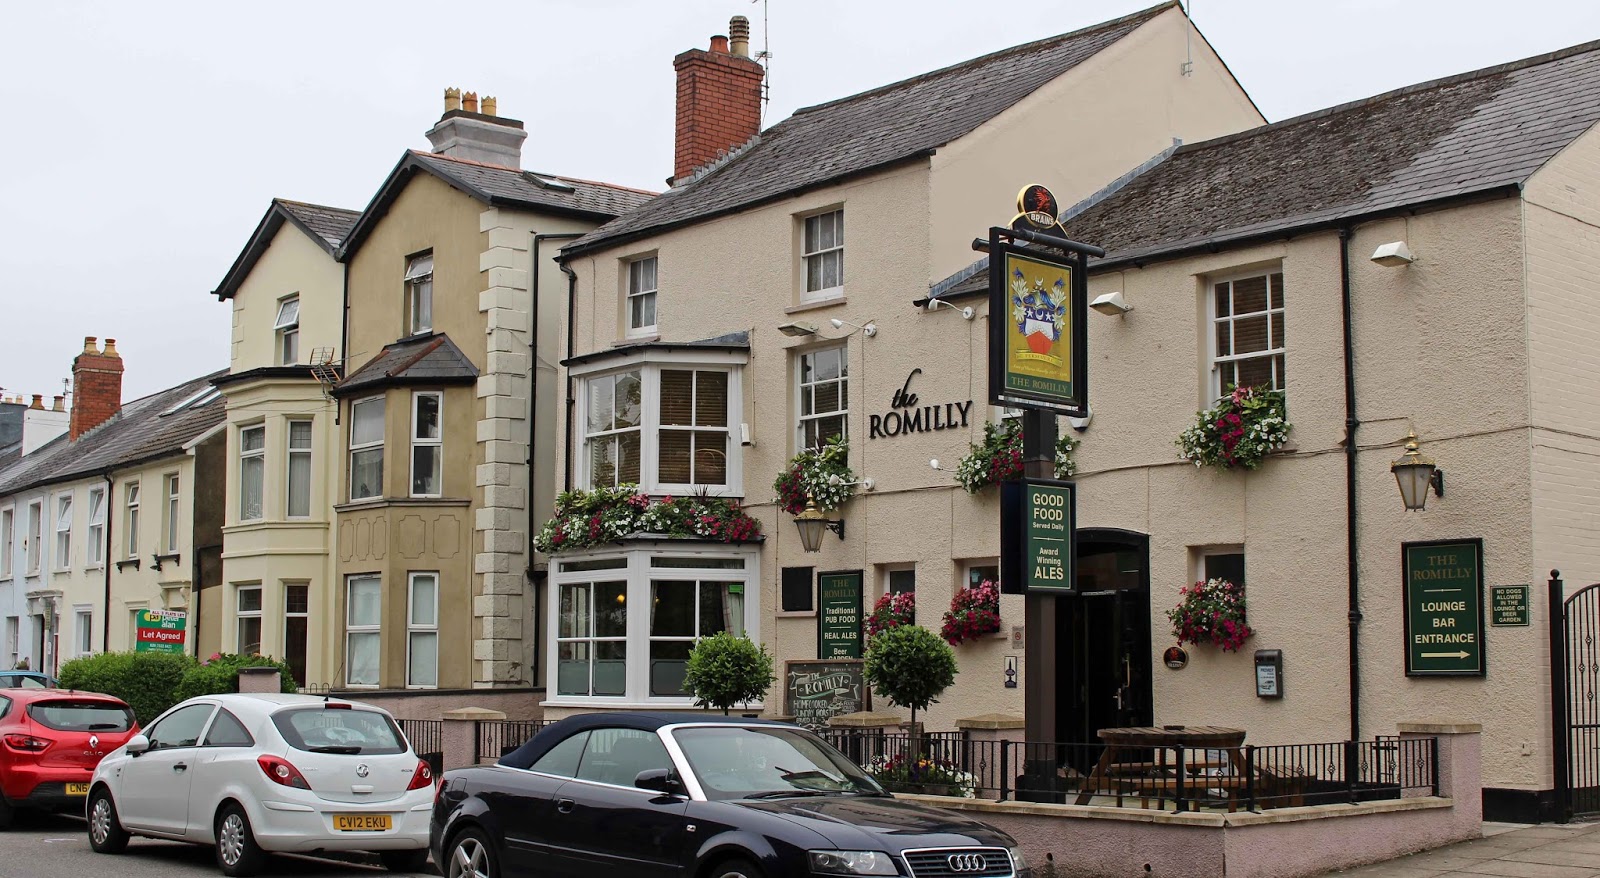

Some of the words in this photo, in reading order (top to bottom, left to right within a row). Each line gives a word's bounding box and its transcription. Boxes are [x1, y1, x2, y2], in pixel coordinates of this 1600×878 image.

[1030, 213, 1054, 226] BRAINS
[891, 368, 922, 409] the
[1011, 376, 1029, 387] THE
[1032, 380, 1067, 393] ROMILLY
[869, 400, 973, 440] ROMILLY
[1032, 493, 1064, 507] GOOD
[1033, 507, 1063, 521] FOOD
[1032, 521, 1051, 529] Served
[1051, 523, 1064, 531] Daily
[1039, 547, 1059, 556] Award
[1036, 556, 1061, 566] Winning
[1427, 555, 1457, 566] THE
[1034, 566, 1064, 580] ALES
[1413, 567, 1472, 580] ROMILLY
[832, 579, 849, 587] THE
[824, 589, 856, 598] ROMILLY
[825, 607, 856, 615] Traditional
[1421, 601, 1466, 612] LOUNGE
[161, 621, 176, 629] alan
[1432, 618, 1455, 628] BAR
[142, 630, 155, 639] Let
[155, 631, 181, 641] Agreed
[824, 632, 840, 640] REAL
[841, 631, 857, 639] ALES
[1415, 633, 1474, 644] ENTRANCE
[805, 676, 845, 695] ROMILLY
[70, 783, 89, 792] CN6
[340, 817, 363, 828] CV12
[366, 817, 386, 828] EKU
